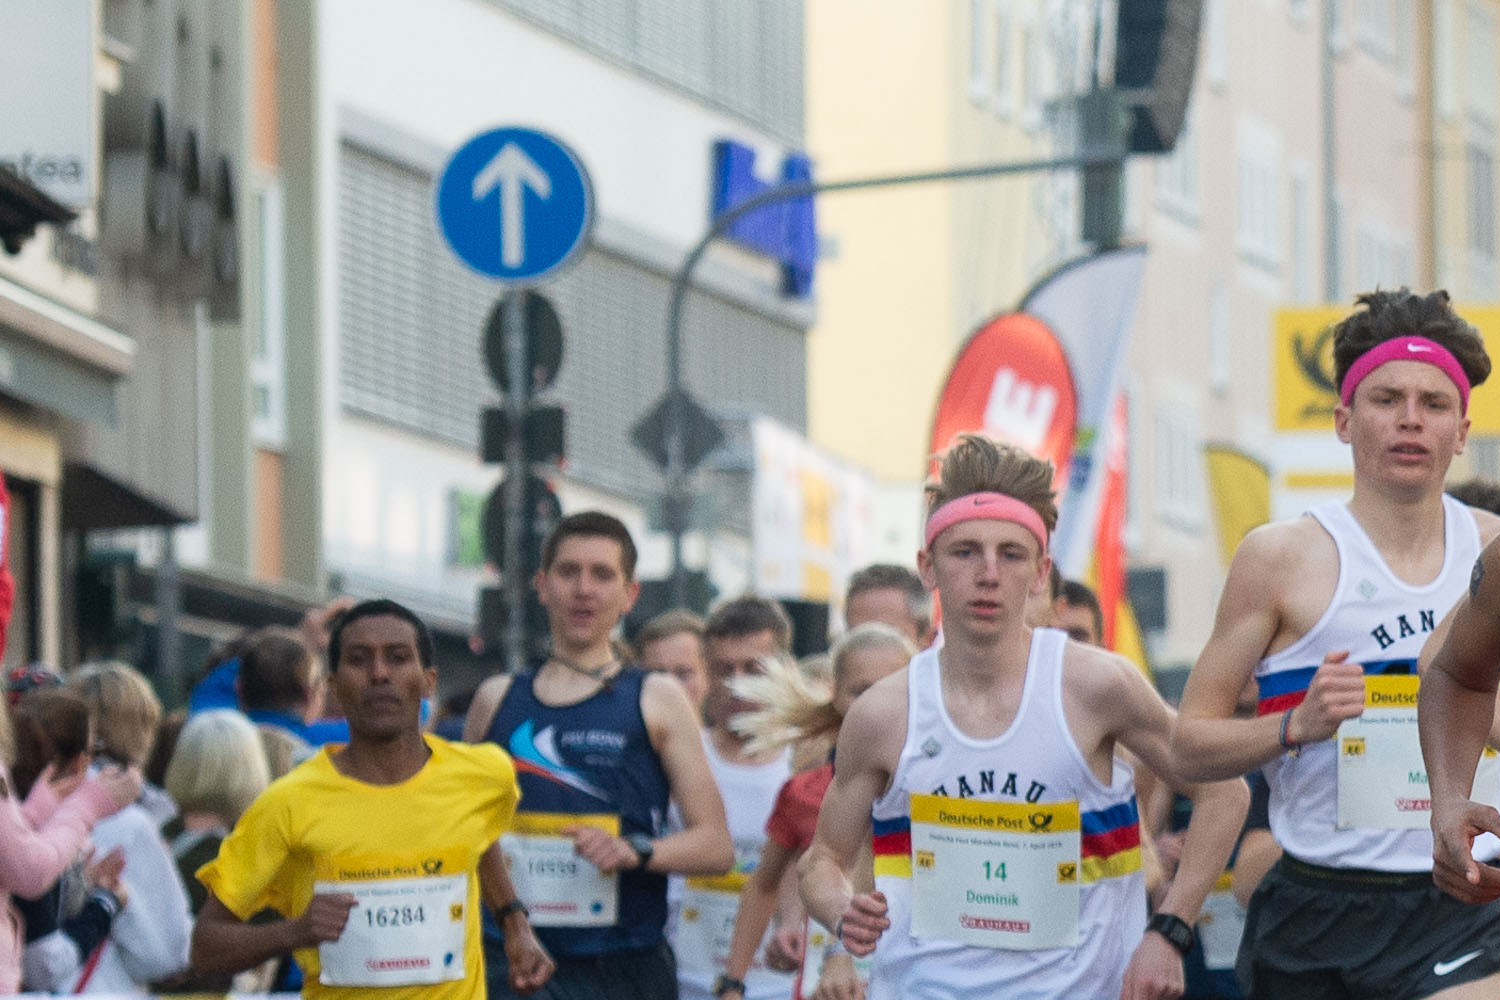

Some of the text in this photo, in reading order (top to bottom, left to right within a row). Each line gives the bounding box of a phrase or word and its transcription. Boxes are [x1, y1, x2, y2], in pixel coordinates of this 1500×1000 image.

[1370, 609, 1435, 651] HAN
[1371, 691, 1419, 704] Deutsc
[1408, 772, 1428, 784] Ma
[939, 810, 1023, 829] Deutsche Post
[983, 860, 1008, 882] 14
[966, 890, 1019, 906] Dominik
[366, 905, 425, 928] 16284
